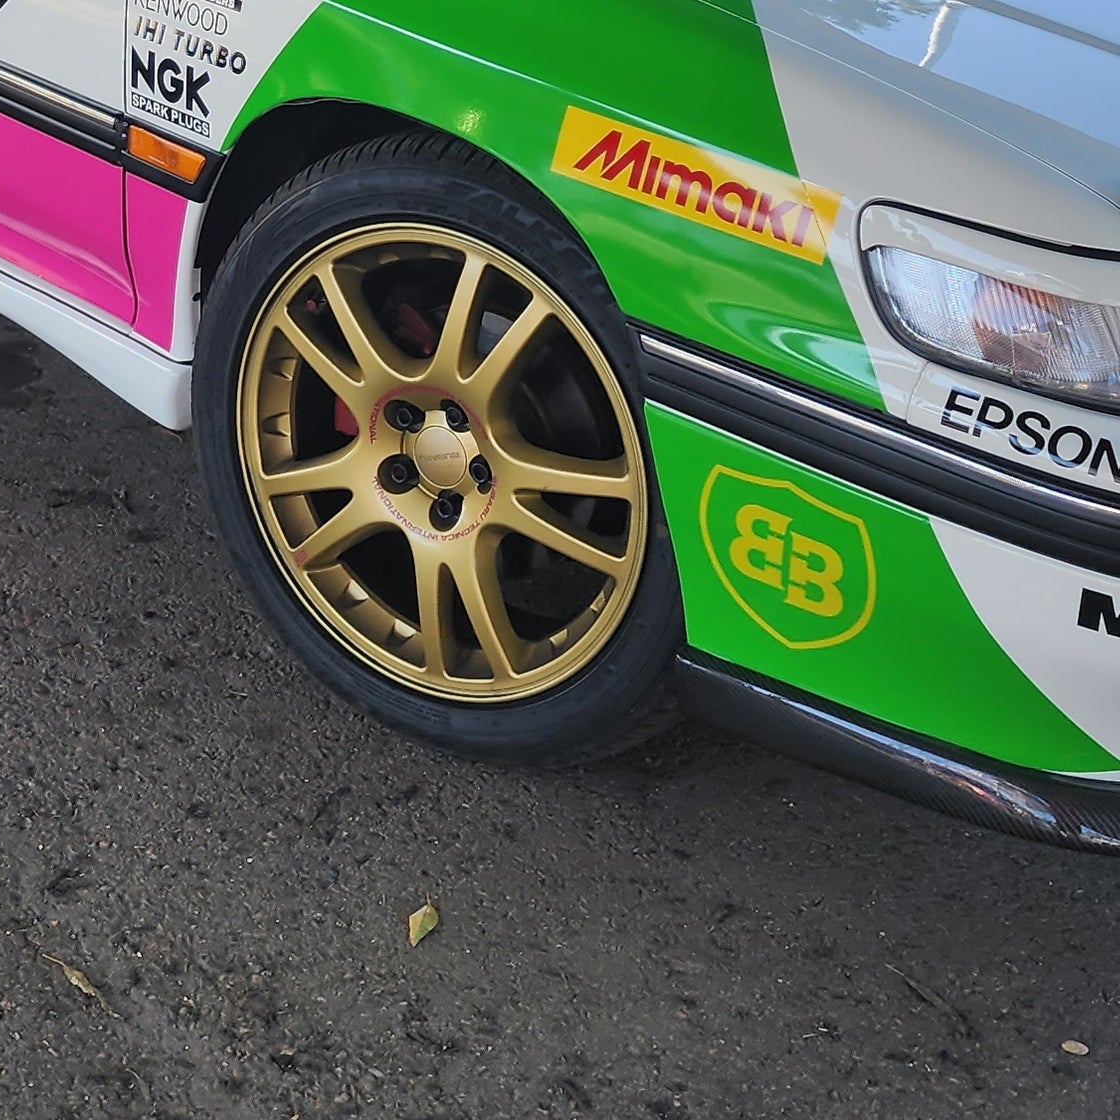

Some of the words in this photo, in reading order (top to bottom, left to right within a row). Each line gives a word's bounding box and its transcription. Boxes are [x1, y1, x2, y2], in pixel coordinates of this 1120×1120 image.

[134, 15, 167, 46] IHI
[173, 27, 247, 75] TURBO
[131, 46, 211, 118] NGK
[132, 94, 170, 121] SPARK
[170, 110, 210, 137] PLUGS
[940, 385, 1120, 484] EPSON
